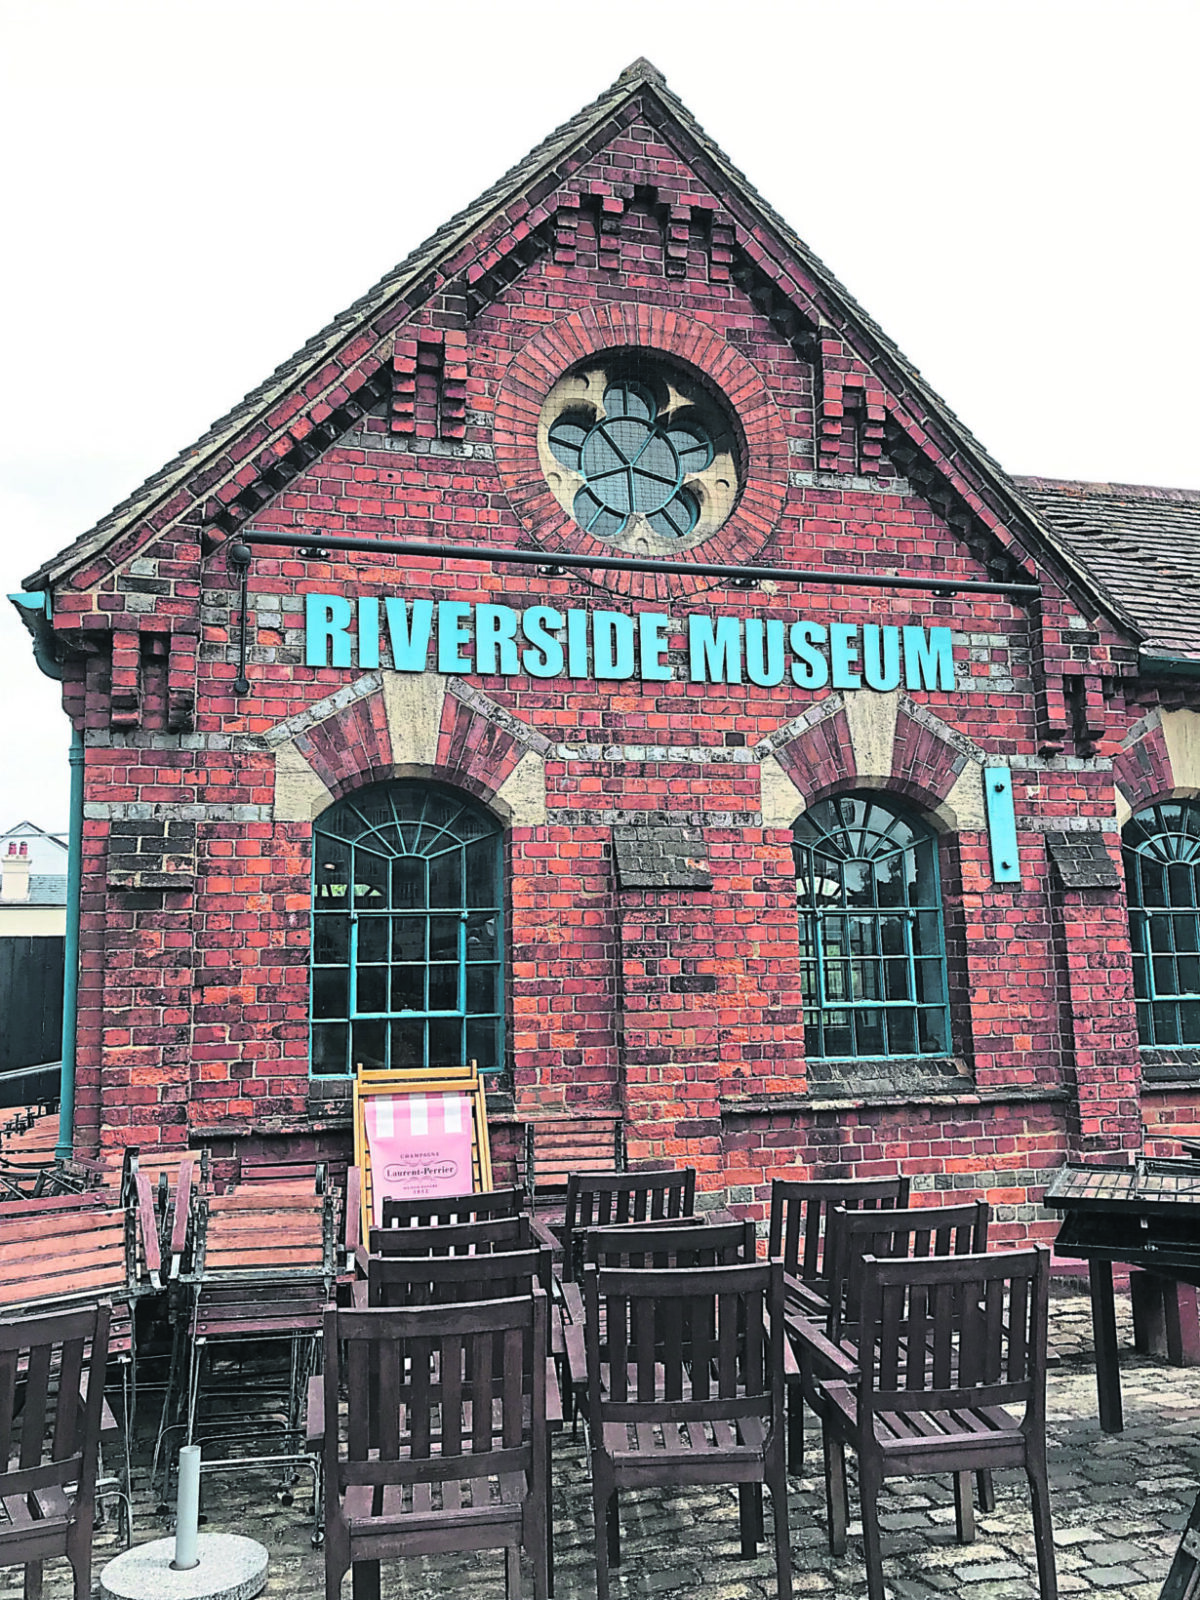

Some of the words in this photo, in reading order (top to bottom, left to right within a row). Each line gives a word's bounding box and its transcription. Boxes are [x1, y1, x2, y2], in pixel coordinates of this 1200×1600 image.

[305, 593, 673, 681] RIVERSIDE
[689, 615, 957, 691] MUSEUM
[387, 1166, 454, 1177] Laurent-Perrier
